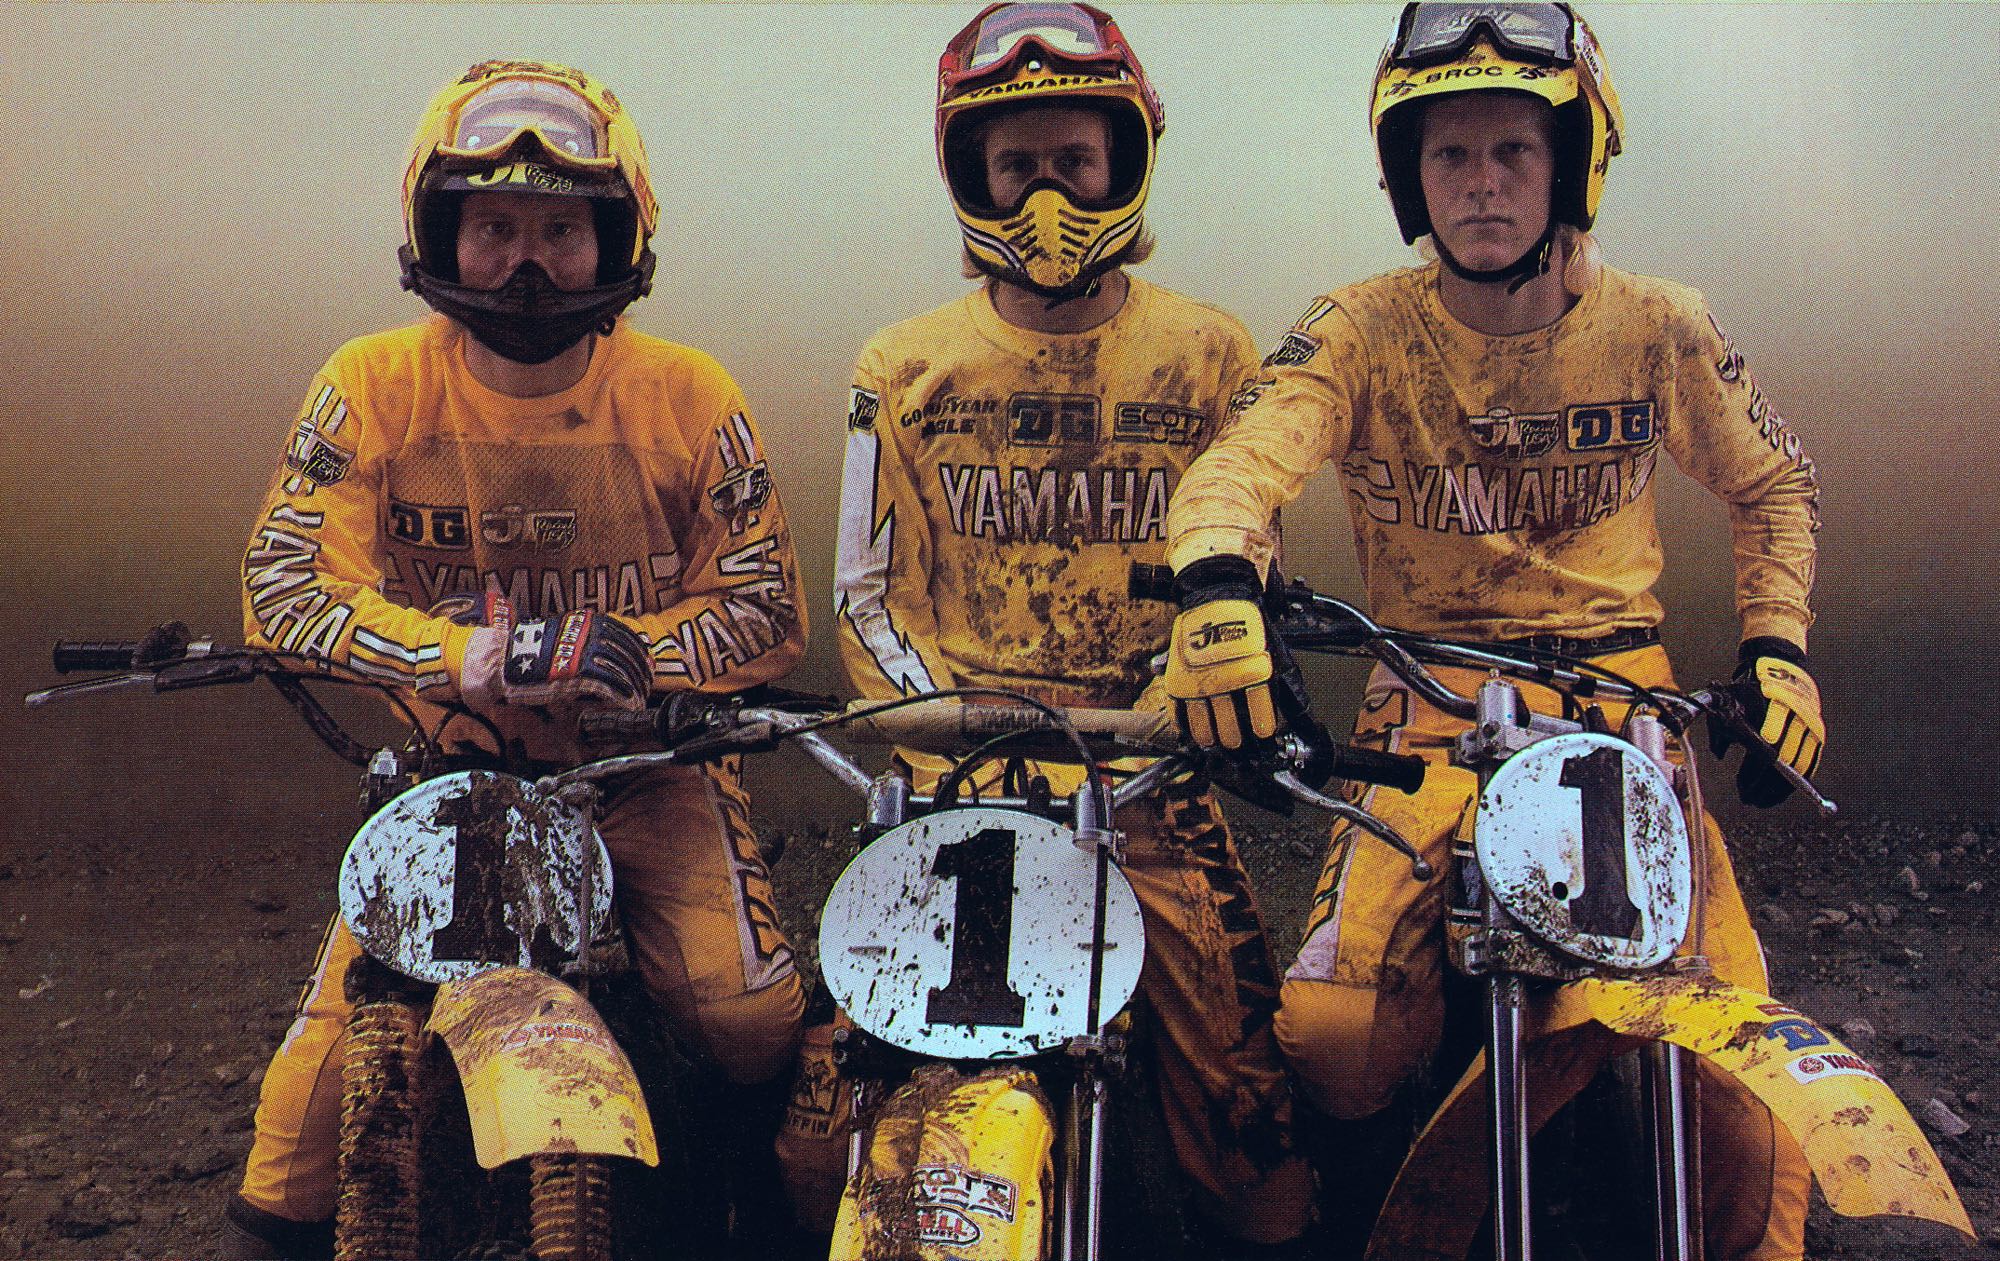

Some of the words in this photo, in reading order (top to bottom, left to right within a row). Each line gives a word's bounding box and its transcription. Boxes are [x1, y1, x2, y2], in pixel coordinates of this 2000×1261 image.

[969, 76, 1104, 98] YAMAHA
[1426, 66, 1503, 84] BROC
[1571, 407, 1652, 447] DG
[939, 463, 1169, 542] YAMAHA
[1405, 459, 1622, 535] YAMAHA
[392, 504, 467, 546] DG
[411, 561, 646, 618] YAMAHA
[1558, 746, 1644, 942] 1
[431, 778, 521, 961] 1
[926, 829, 1026, 1028] 1
[1764, 1018, 1830, 1053] D
[920, 1212, 968, 1236] ELL
